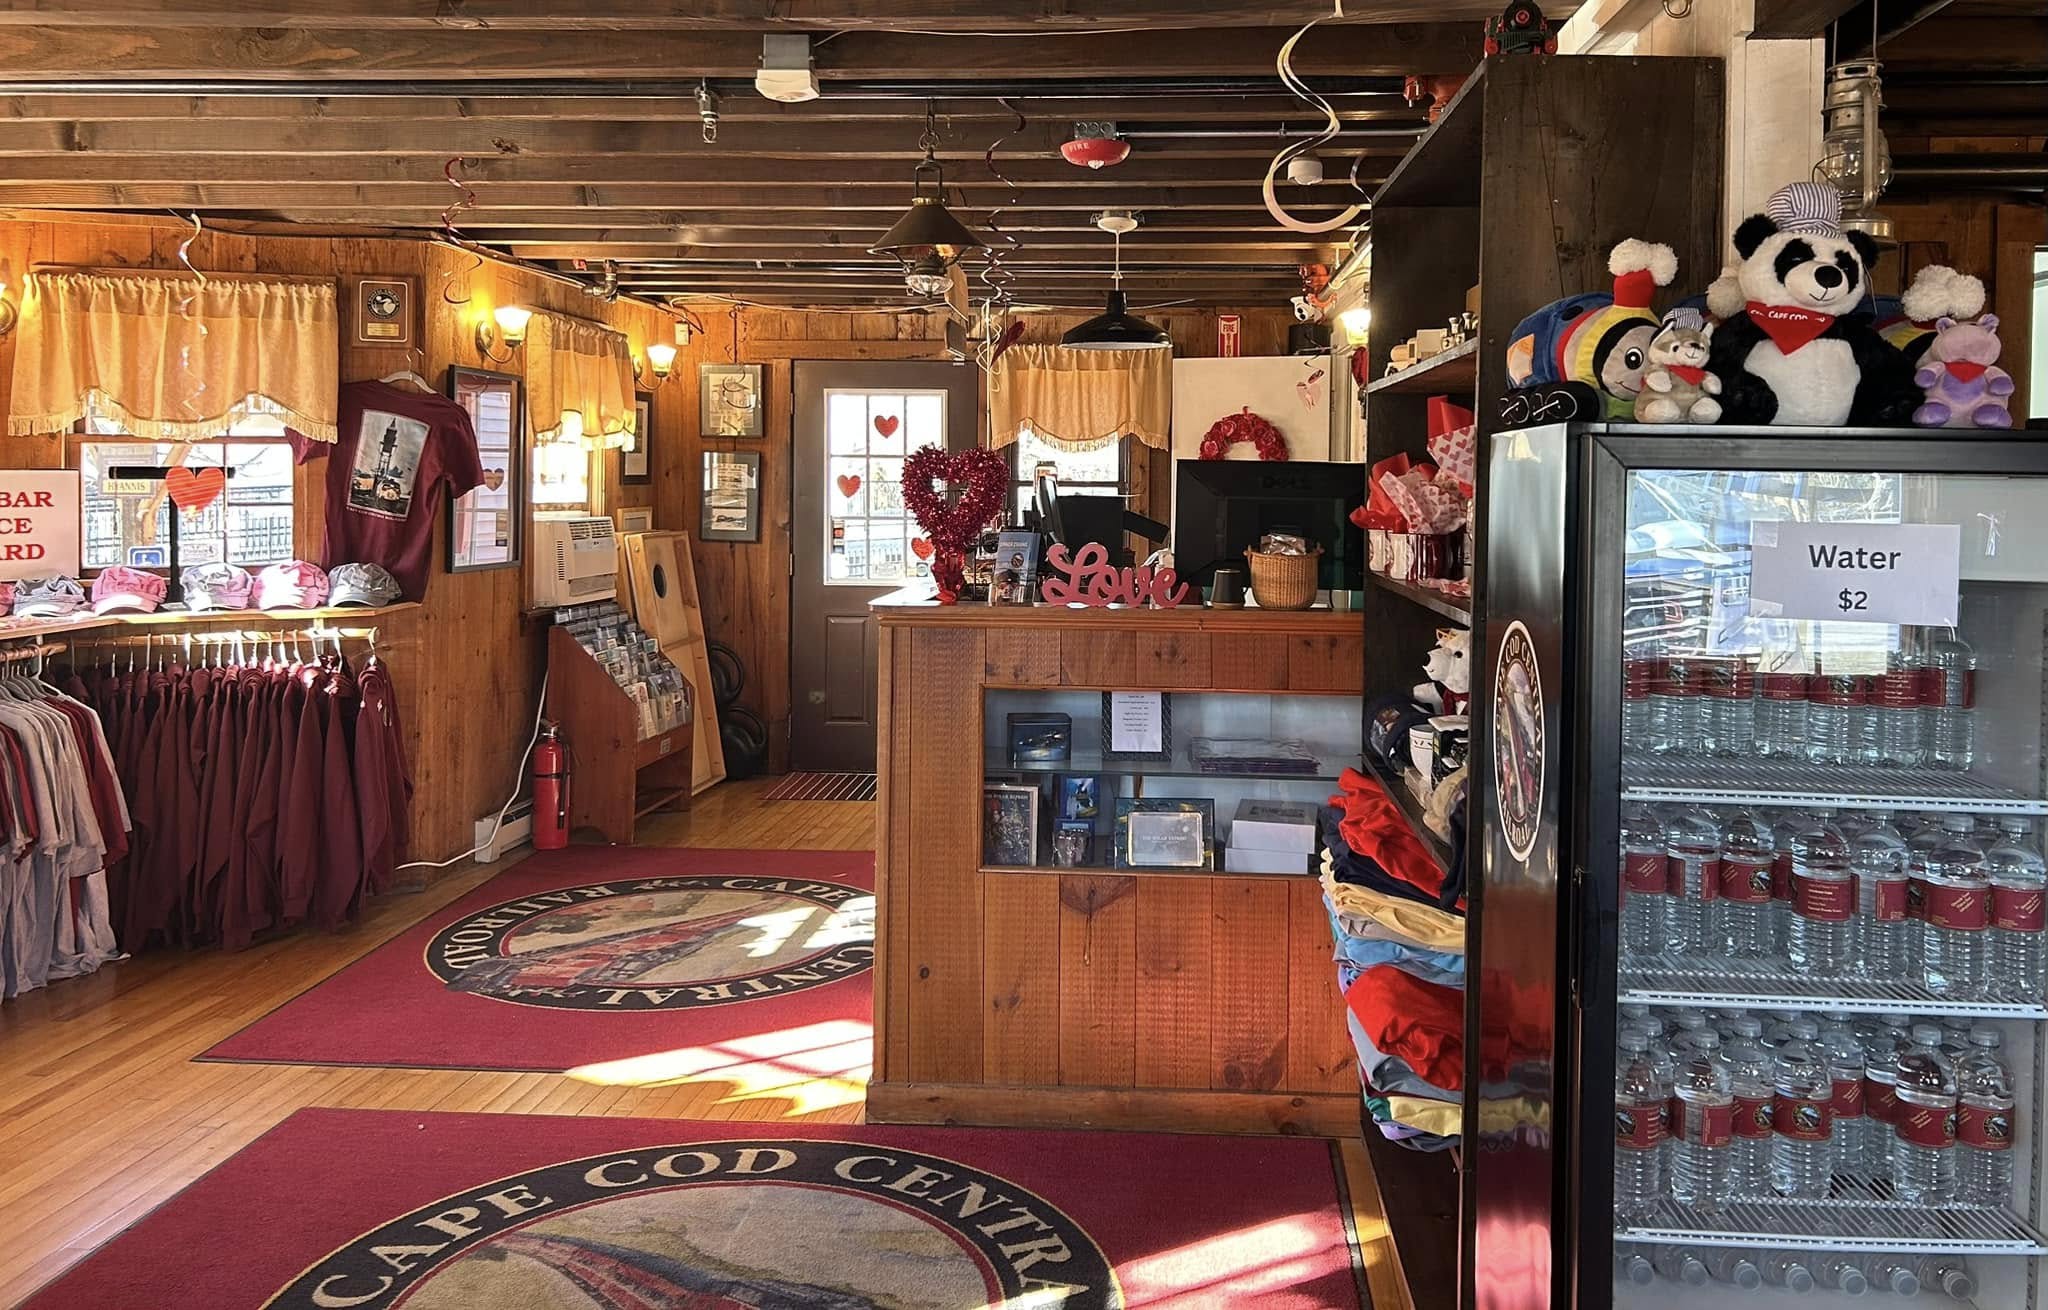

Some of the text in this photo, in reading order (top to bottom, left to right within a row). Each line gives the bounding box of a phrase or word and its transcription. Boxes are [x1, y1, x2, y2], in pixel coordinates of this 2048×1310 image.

[1069, 143, 1089, 152] FIRE
[0, 544, 45, 560] RD
[1808, 544, 1901, 570] Water
[1042, 542, 1189, 609] Love
[1838, 587, 1868, 612] $2
[1505, 635, 1520, 664] COD
[722, 879, 856, 902] CAPE
[311, 1184, 553, 1308] CAPE
[583, 1148, 798, 1188] COD
